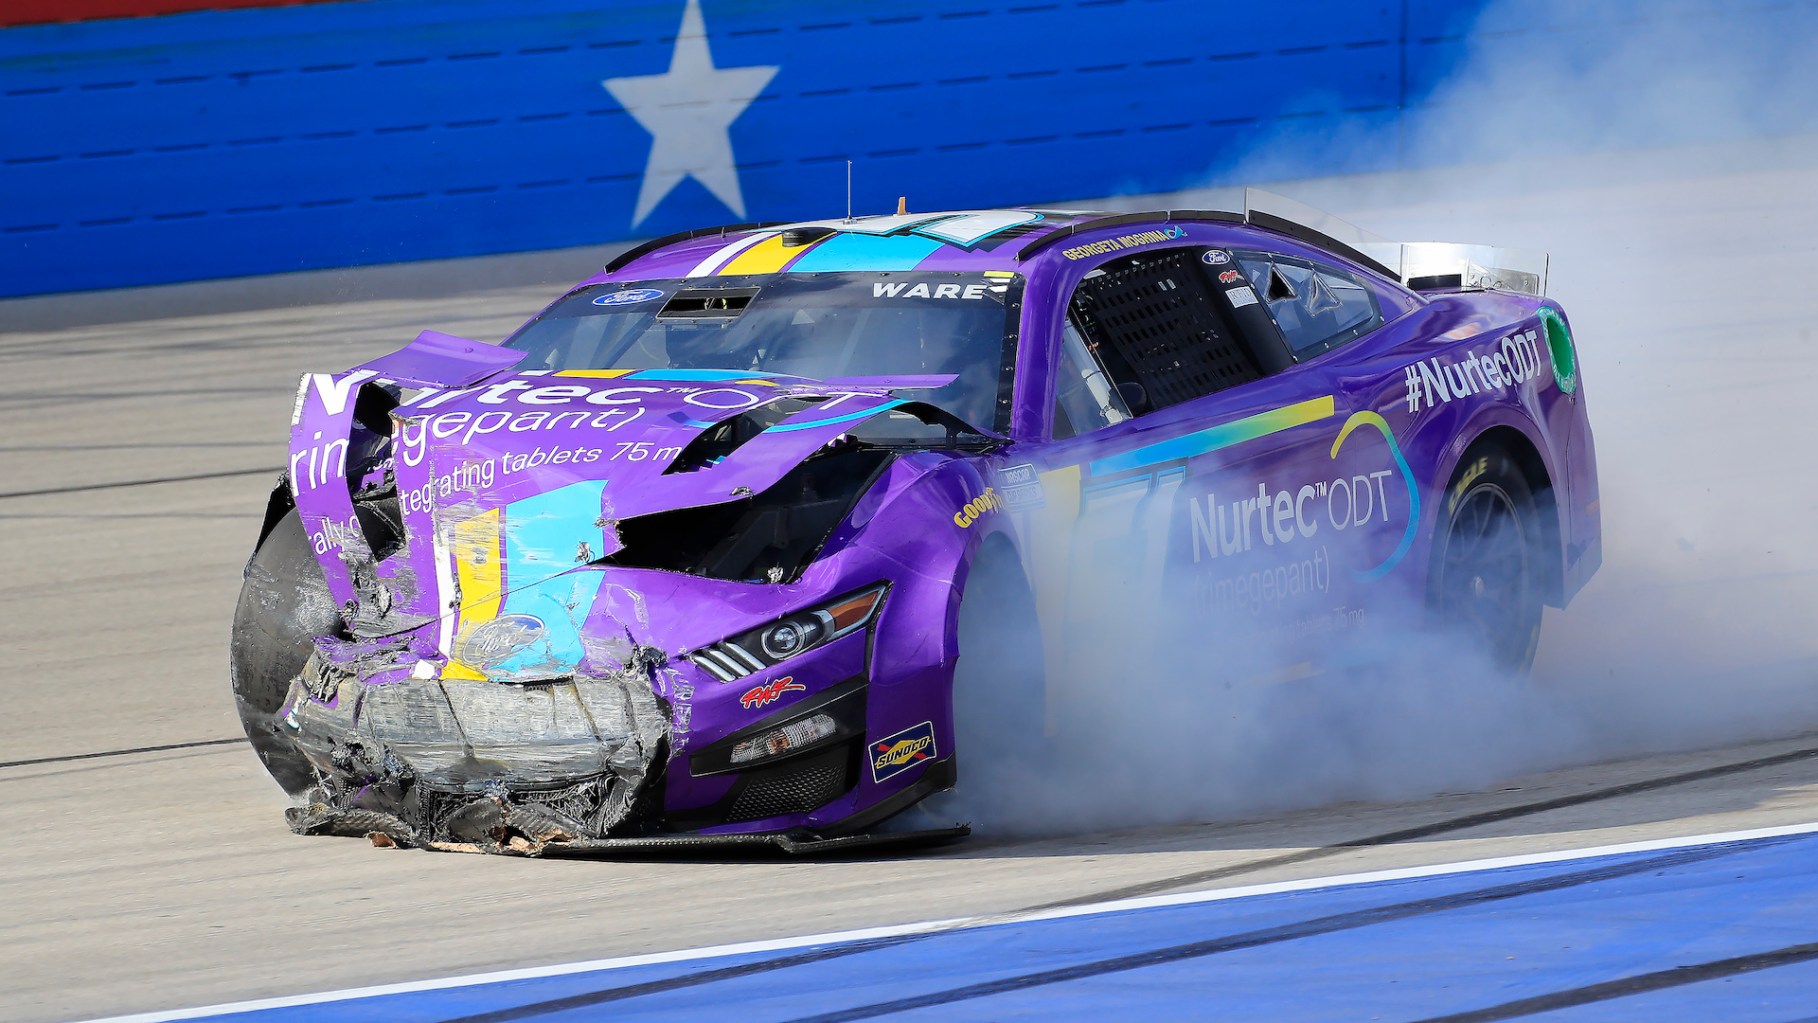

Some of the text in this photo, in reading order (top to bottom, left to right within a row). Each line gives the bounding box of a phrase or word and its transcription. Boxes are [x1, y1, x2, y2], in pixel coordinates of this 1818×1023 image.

[1062, 230, 1169, 261] GEORGETA MOGHINA
[873, 282, 985, 299] WARE
[1405, 330, 1541, 413] #NurtecODT
[502, 441, 603, 476] tablets
[609, 441, 655, 462] 75
[1328, 470, 1392, 530] ODT
[1333, 605, 1348, 628] 75
[875, 735, 931, 769] SUNOCO
